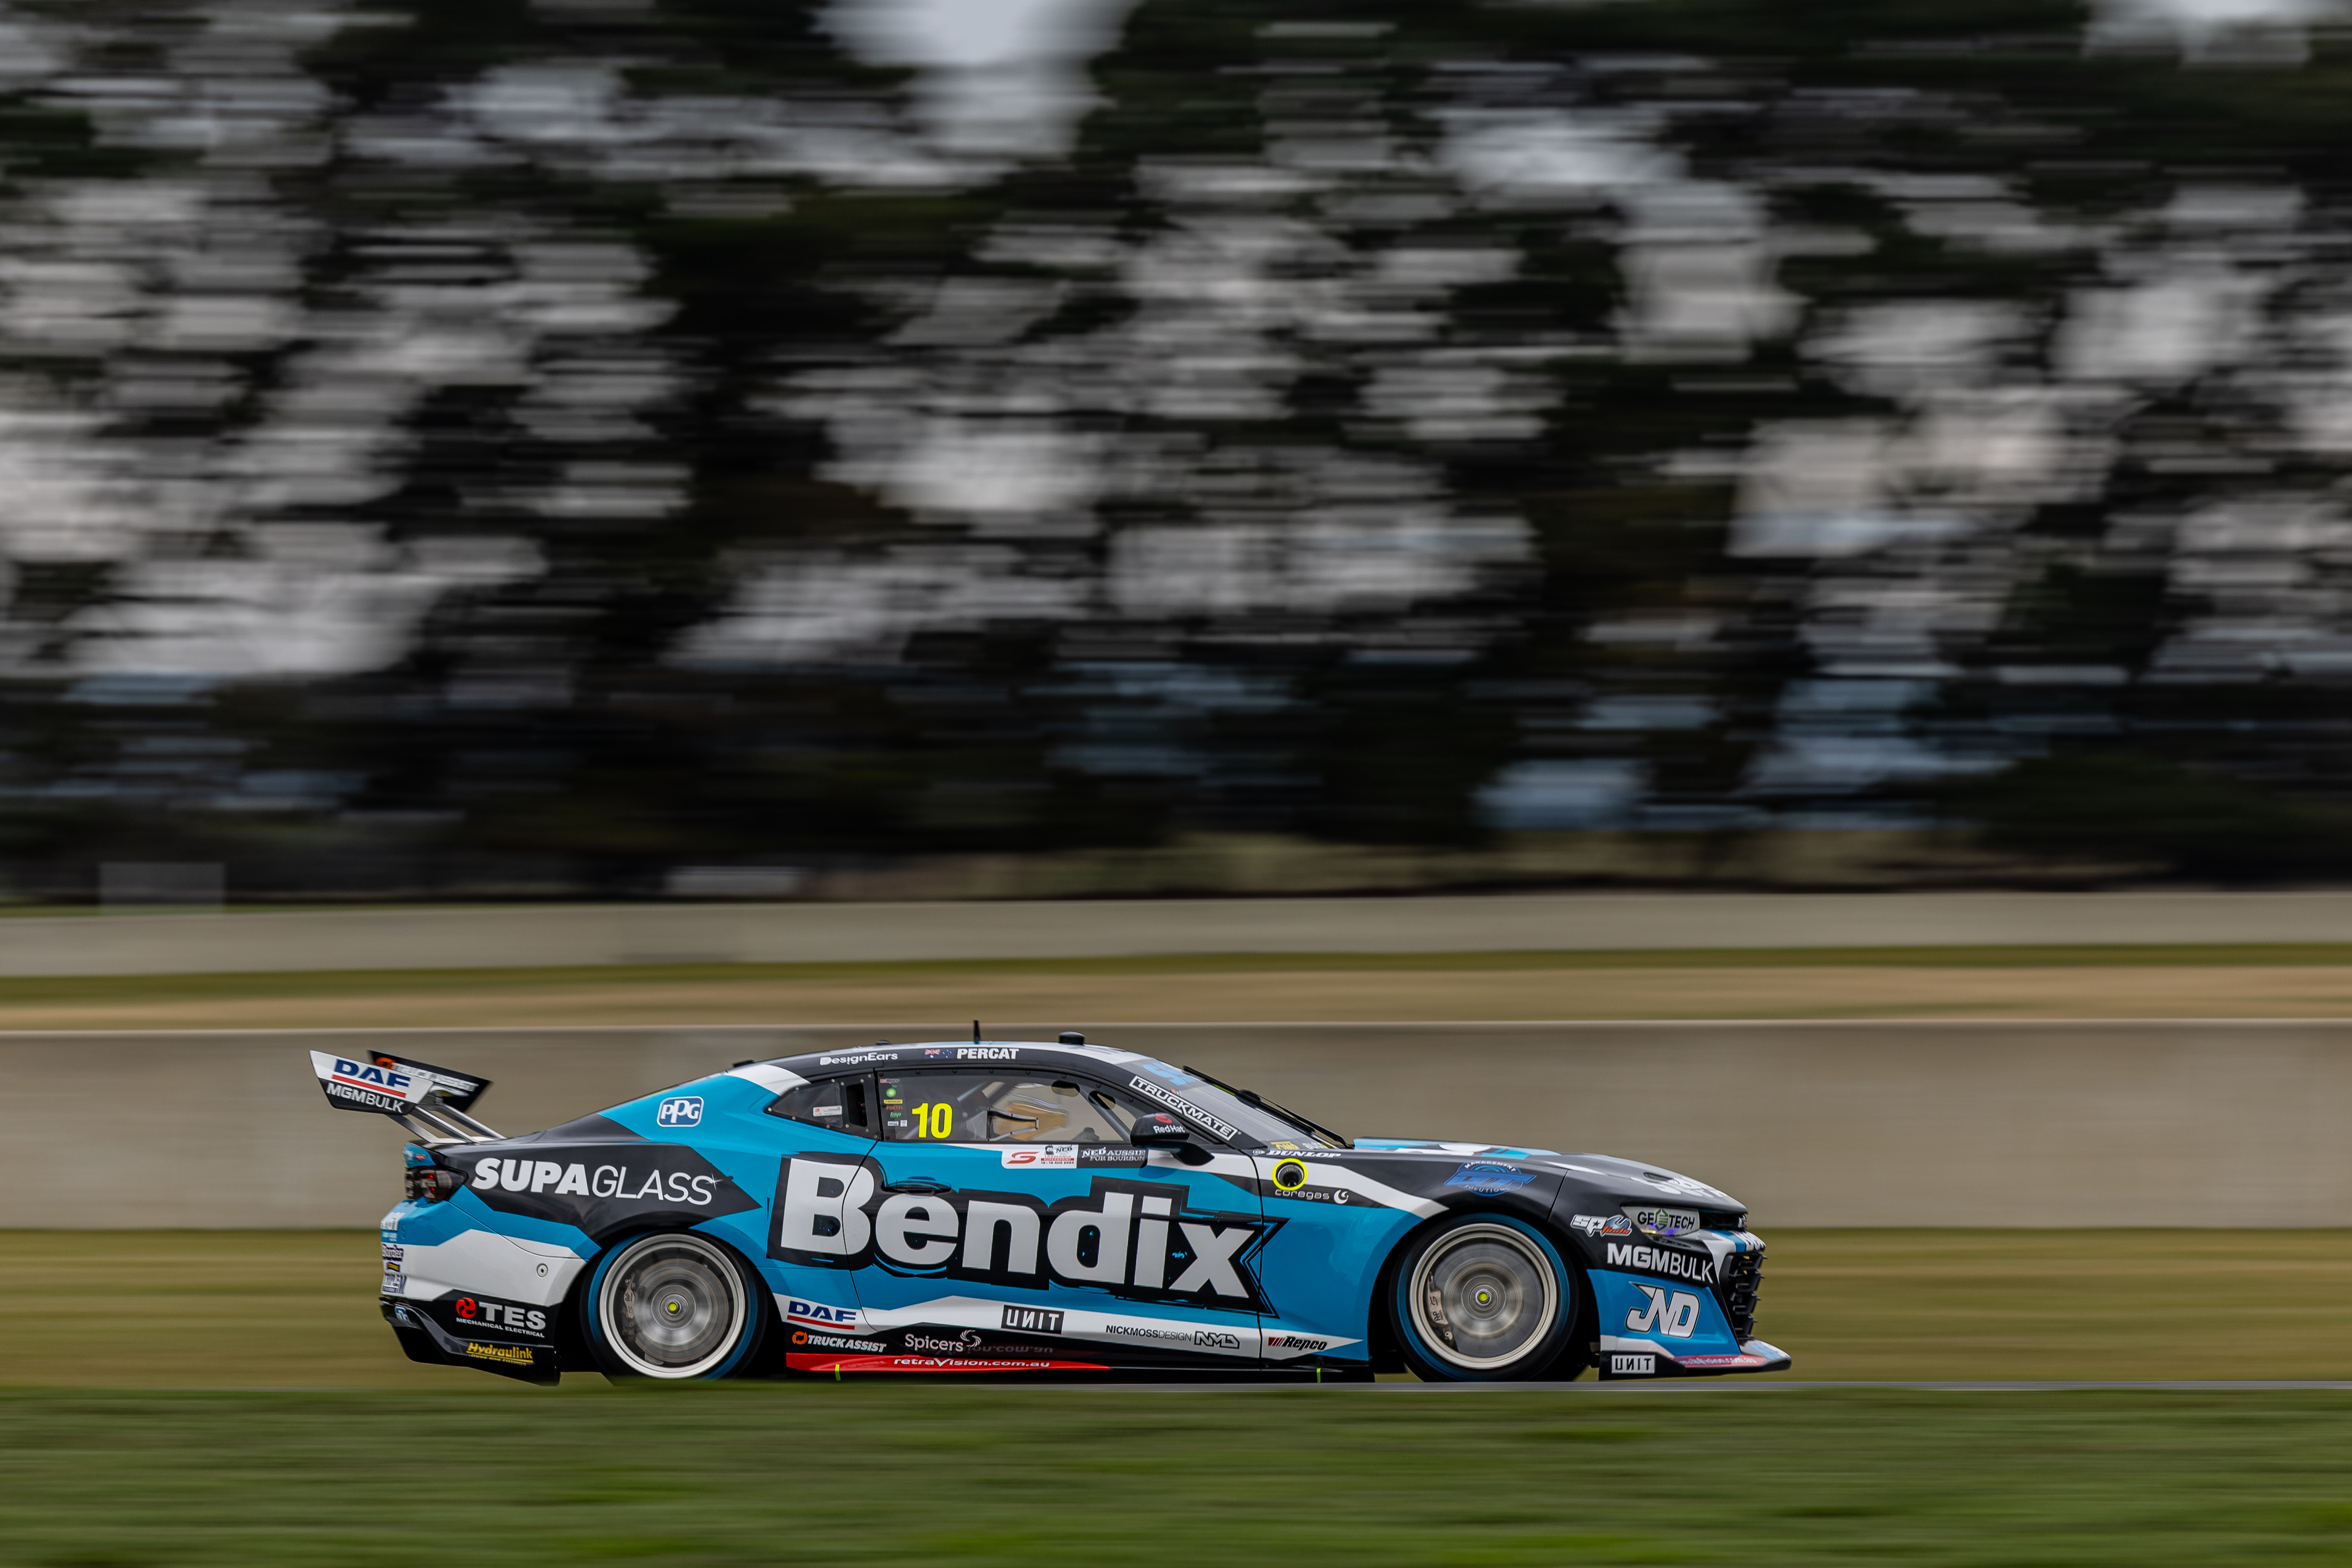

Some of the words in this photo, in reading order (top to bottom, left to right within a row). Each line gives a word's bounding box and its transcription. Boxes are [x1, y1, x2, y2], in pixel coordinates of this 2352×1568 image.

[820, 1052, 898, 1065] DesignEars
[956, 1047, 1019, 1059] PERCAT
[334, 1059, 411, 1087] DAF
[327, 1082, 405, 1113] MGMBULK
[1137, 1079, 1232, 1136] TRUCKMATE
[661, 1100, 701, 1123] PPG
[912, 1103, 952, 1138] 10
[1266, 1149, 1342, 1158] DUNLOP
[1464, 1161, 1516, 1172] MANAGEMENT
[471, 1158, 712, 1205] SUPAGLASS
[1275, 1189, 1329, 1200] coregas
[780, 1158, 1255, 1298] Bendix
[1572, 1215, 1607, 1235] SP
[1608, 1243, 1714, 1284] MGMBULK
[479, 1301, 546, 1330] TES
[788, 1301, 856, 1322] DAF
[1626, 1281, 1700, 1338] JND
[456, 1317, 503, 1330] MECHANICAL
[505, 1326, 545, 1338] ELECTRICAL
[1106, 1325, 1192, 1342] NICKMOSSDESIGN
[467, 1342, 533, 1359] Hydraulink
[905, 1334, 964, 1352] Spicers
[1282, 1336, 1328, 1352] Repco
[894, 1358, 1050, 1367] retraVision.com.au
